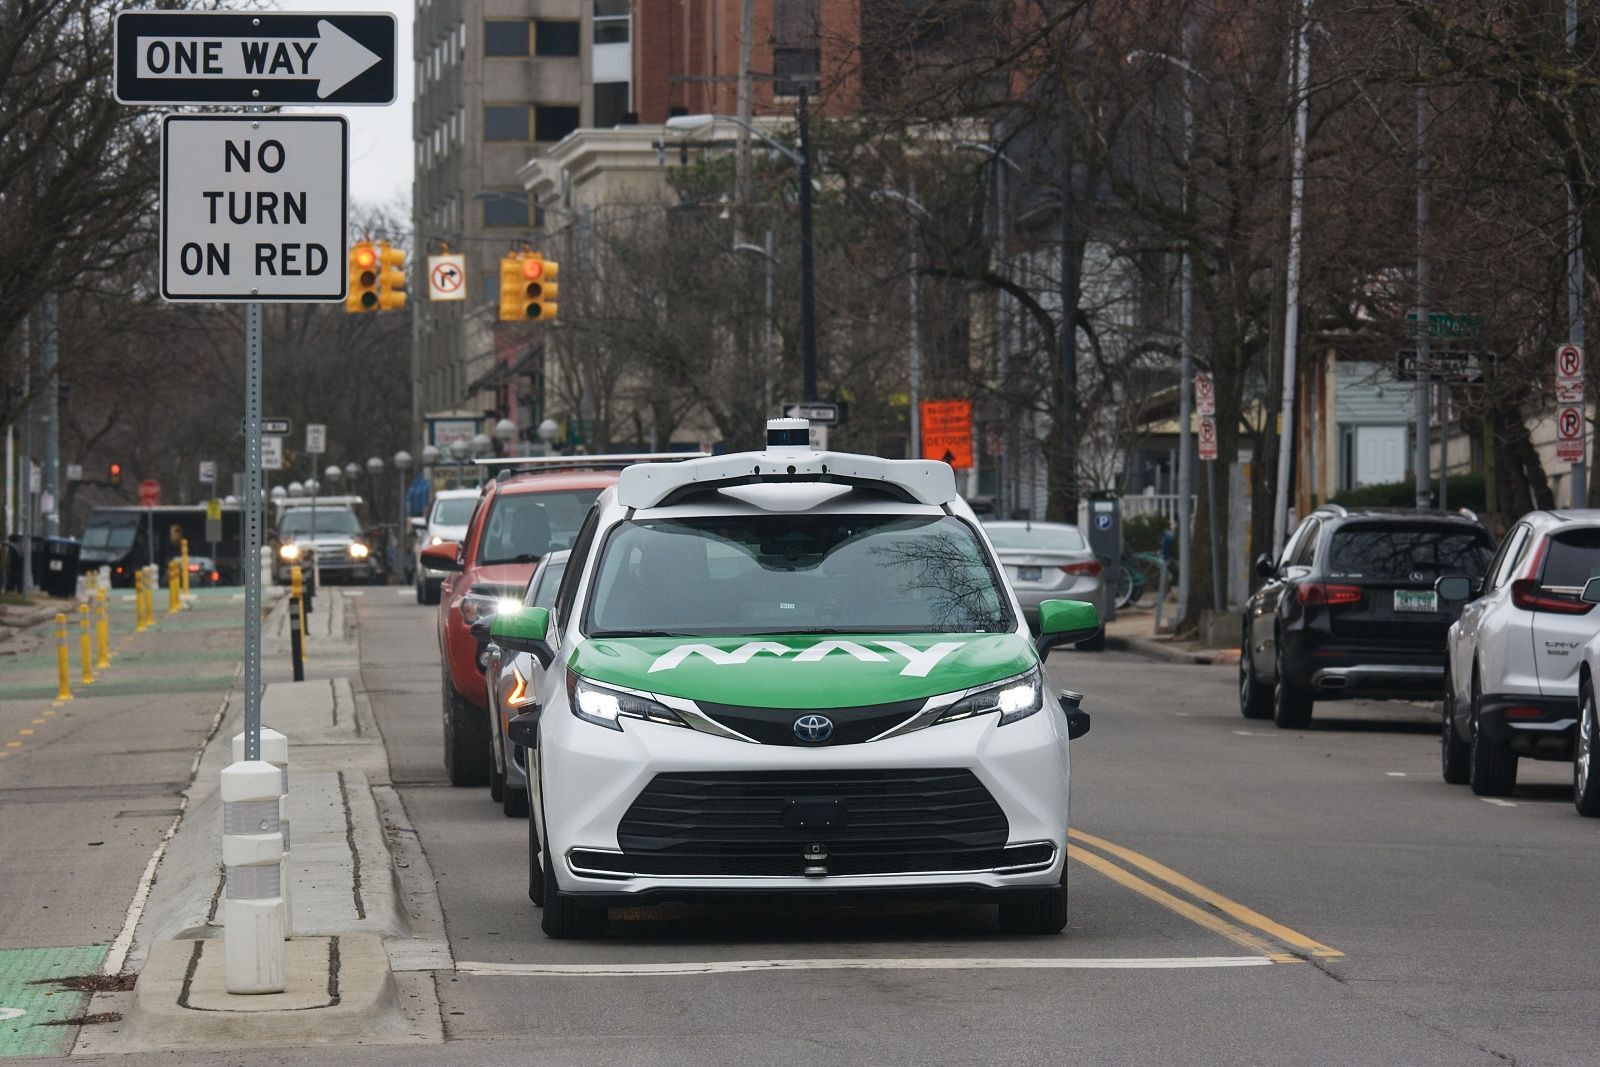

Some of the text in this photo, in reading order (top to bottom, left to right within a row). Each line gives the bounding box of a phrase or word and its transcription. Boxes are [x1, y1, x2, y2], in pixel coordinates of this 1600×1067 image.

[146, 41, 318, 75] ONE WAY
[224, 139, 286, 173] NO
[203, 191, 307, 225] TURN
[180, 242, 328, 276] ON RED
[926, 436, 969, 446] DETOUR
[647, 640, 967, 677] MAY
[1545, 641, 1579, 649] CR-V
